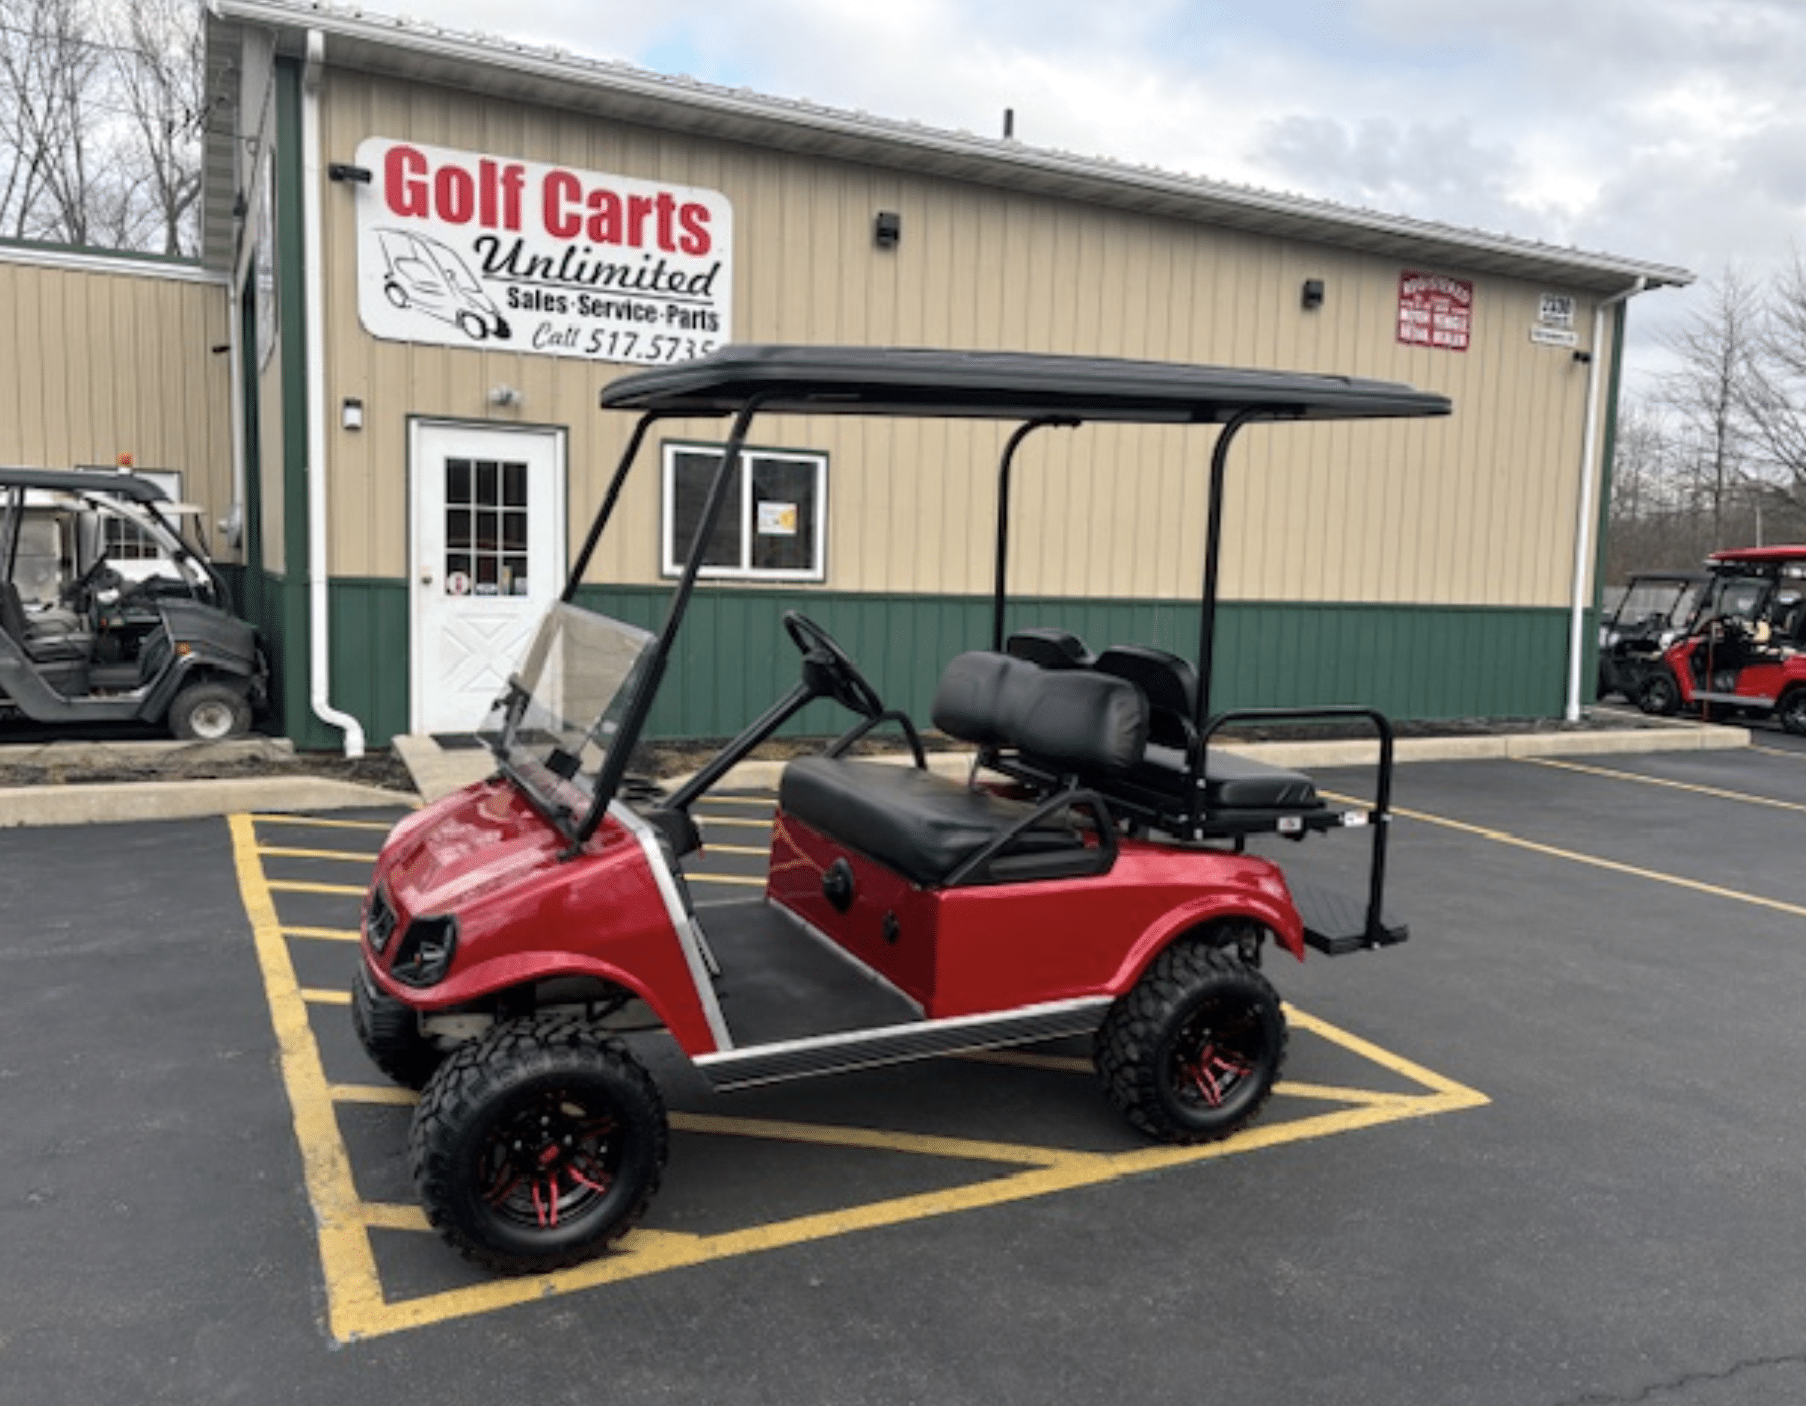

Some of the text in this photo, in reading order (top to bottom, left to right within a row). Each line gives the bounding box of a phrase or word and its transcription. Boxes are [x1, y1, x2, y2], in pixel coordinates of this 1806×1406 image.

[384, 145, 712, 257] Golf Carts
[473, 235, 721, 297] Unlimited
[507, 287, 720, 332] Sales Service Parts
[532, 321, 581, 350] Call
